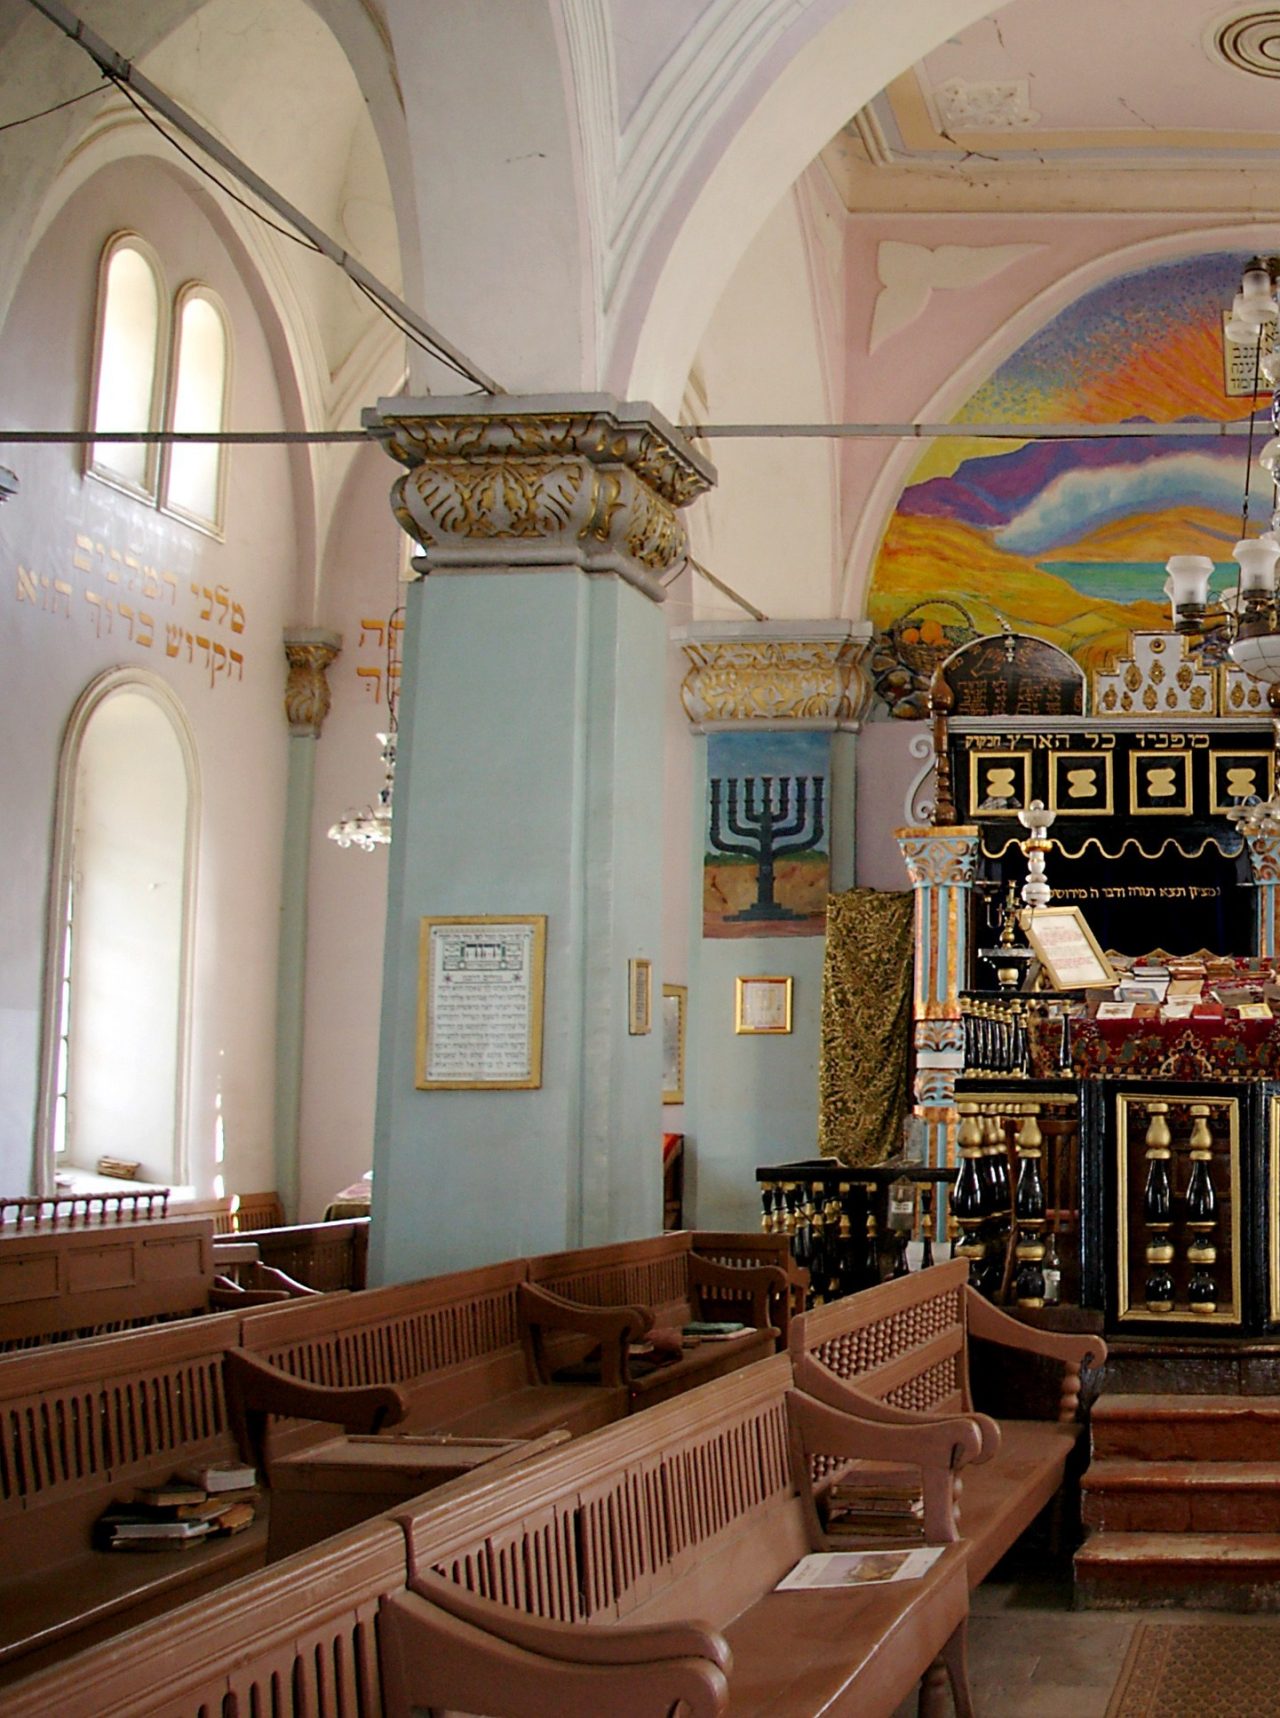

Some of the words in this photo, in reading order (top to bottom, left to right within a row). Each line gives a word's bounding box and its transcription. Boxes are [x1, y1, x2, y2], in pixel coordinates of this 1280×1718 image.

[16, 564, 72, 619] הוא
[86, 588, 155, 648] ברוך
[191, 582, 246, 634] מלכי
[165, 622, 244, 689] הקדוש
[1006, 734, 1070, 750] הארץ
[1084, 733, 1116, 748] כל
